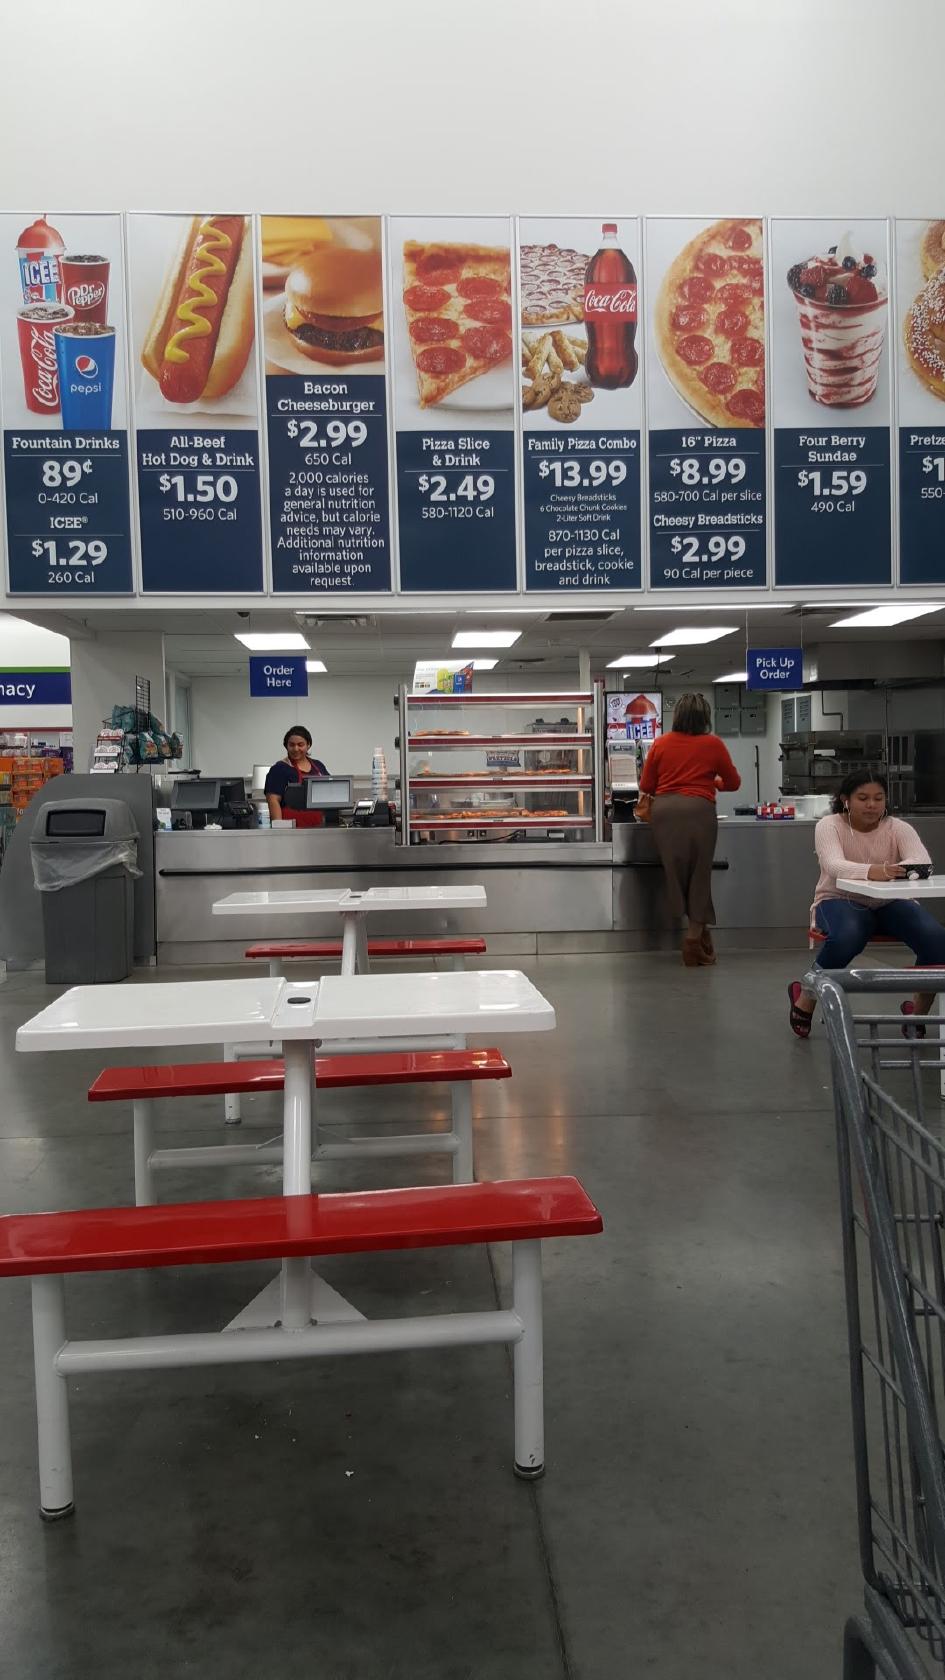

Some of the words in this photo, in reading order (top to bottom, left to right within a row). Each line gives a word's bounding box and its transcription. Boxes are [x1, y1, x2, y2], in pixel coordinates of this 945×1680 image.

[22, 258, 60, 285] ICEE
[81, 284, 95, 295] Dr
[68, 287, 103, 306] Pepper
[70, 383, 102, 395] pepsi
[304, 382, 347, 394] Bacon
[278, 399, 375, 413] Cheeseburger
[288, 419, 367, 447] $2.99
[12, 437, 72, 448] Fountain
[75, 437, 119, 448] Drinks
[171, 436, 225, 448] All-Beef
[423, 438, 455, 450] Pizza
[459, 437, 490, 449] Slice
[528, 438, 564, 452] Family
[568, 438, 596, 449] Pizza
[599, 437, 636, 449] Combo
[704, 436, 736, 446] Pizza
[800, 436, 828, 446] Four
[831, 435, 865, 448] Berry
[143, 453, 166, 465] Hot
[170, 453, 198, 467] Dog
[202, 453, 212, 465] &
[216, 453, 254, 465] Drink
[305, 453, 329, 465] 650
[333, 453, 351, 465] Cal
[433, 455, 441, 466] &
[445, 454, 480, 465] Drink
[809, 451, 857, 462] Sundae
[43, 459, 92, 487] 89¢
[539, 460, 626, 486] $13.99
[670, 458, 745, 485] $8.99
[290, 472, 323, 486] 2,000
[326, 472, 368, 483] calories
[798, 470, 867, 495] $1.59
[160, 473, 238, 502] $1.50
[285, 488, 291, 496] a
[295, 485, 313, 499] day
[318, 485, 326, 496] is
[330, 485, 354, 496] used
[359, 485, 374, 496] for
[419, 474, 494, 501] $2.49
[38, 493, 75, 503] 0-420
[80, 493, 98, 503] Cal
[550, 494, 576, 502] Cheesy
[577, 493, 616, 501] Breadsticks
[654, 491, 699, 502] 580-700
[703, 490, 718, 501] Cal
[722, 493, 738, 502] per
[740, 489, 761, 500] slice
[284, 497, 324, 513] general
[328, 498, 375, 509] nutrition
[811, 501, 834, 512] 490
[837, 501, 854, 512] Cal
[164, 508, 214, 520] 510-960
[218, 508, 236, 520] Cal
[281, 510, 318, 525] advice,
[322, 510, 339, 522] but
[343, 511, 380, 522] calorie
[422, 507, 473, 518] 580-1120
[476, 507, 493, 517] Cal
[654, 515, 695, 528] Cheesy
[698, 513, 763, 525] Breadsticks
[287, 524, 319, 535] needs
[323, 527, 345, 539] may
[349, 527, 374, 539] vary.
[549, 530, 598, 541] 870-1130
[602, 529, 619, 540] Cal
[277, 536, 334, 548] Additional
[338, 535, 384, 547] nutrition
[32, 539, 107, 566] $1.29
[300, 549, 363, 560] information
[545, 548, 562, 558] per
[566, 545, 593, 558] pizza
[597, 544, 623, 556] slice,
[671, 536, 745, 562] $2.99
[293, 562, 340, 573] available
[345, 565, 371, 577] upon
[535, 559, 594, 571] breadstick,
[598, 558, 633, 569] cookie
[49, 572, 72, 583] 260
[75, 571, 94, 583] Cal
[559, 574, 578, 585] and
[583, 574, 610, 584] drink
[664, 569, 679, 578] 90
[683, 568, 700, 578] Cal
[703, 570, 721, 580] per
[724, 568, 753, 579] piece
[264, 665, 294, 675] Order
[757, 658, 776, 667] Pick
[778, 658, 794, 670] Up
[760, 669, 789, 679] Order
[267, 677, 291, 686] Here
